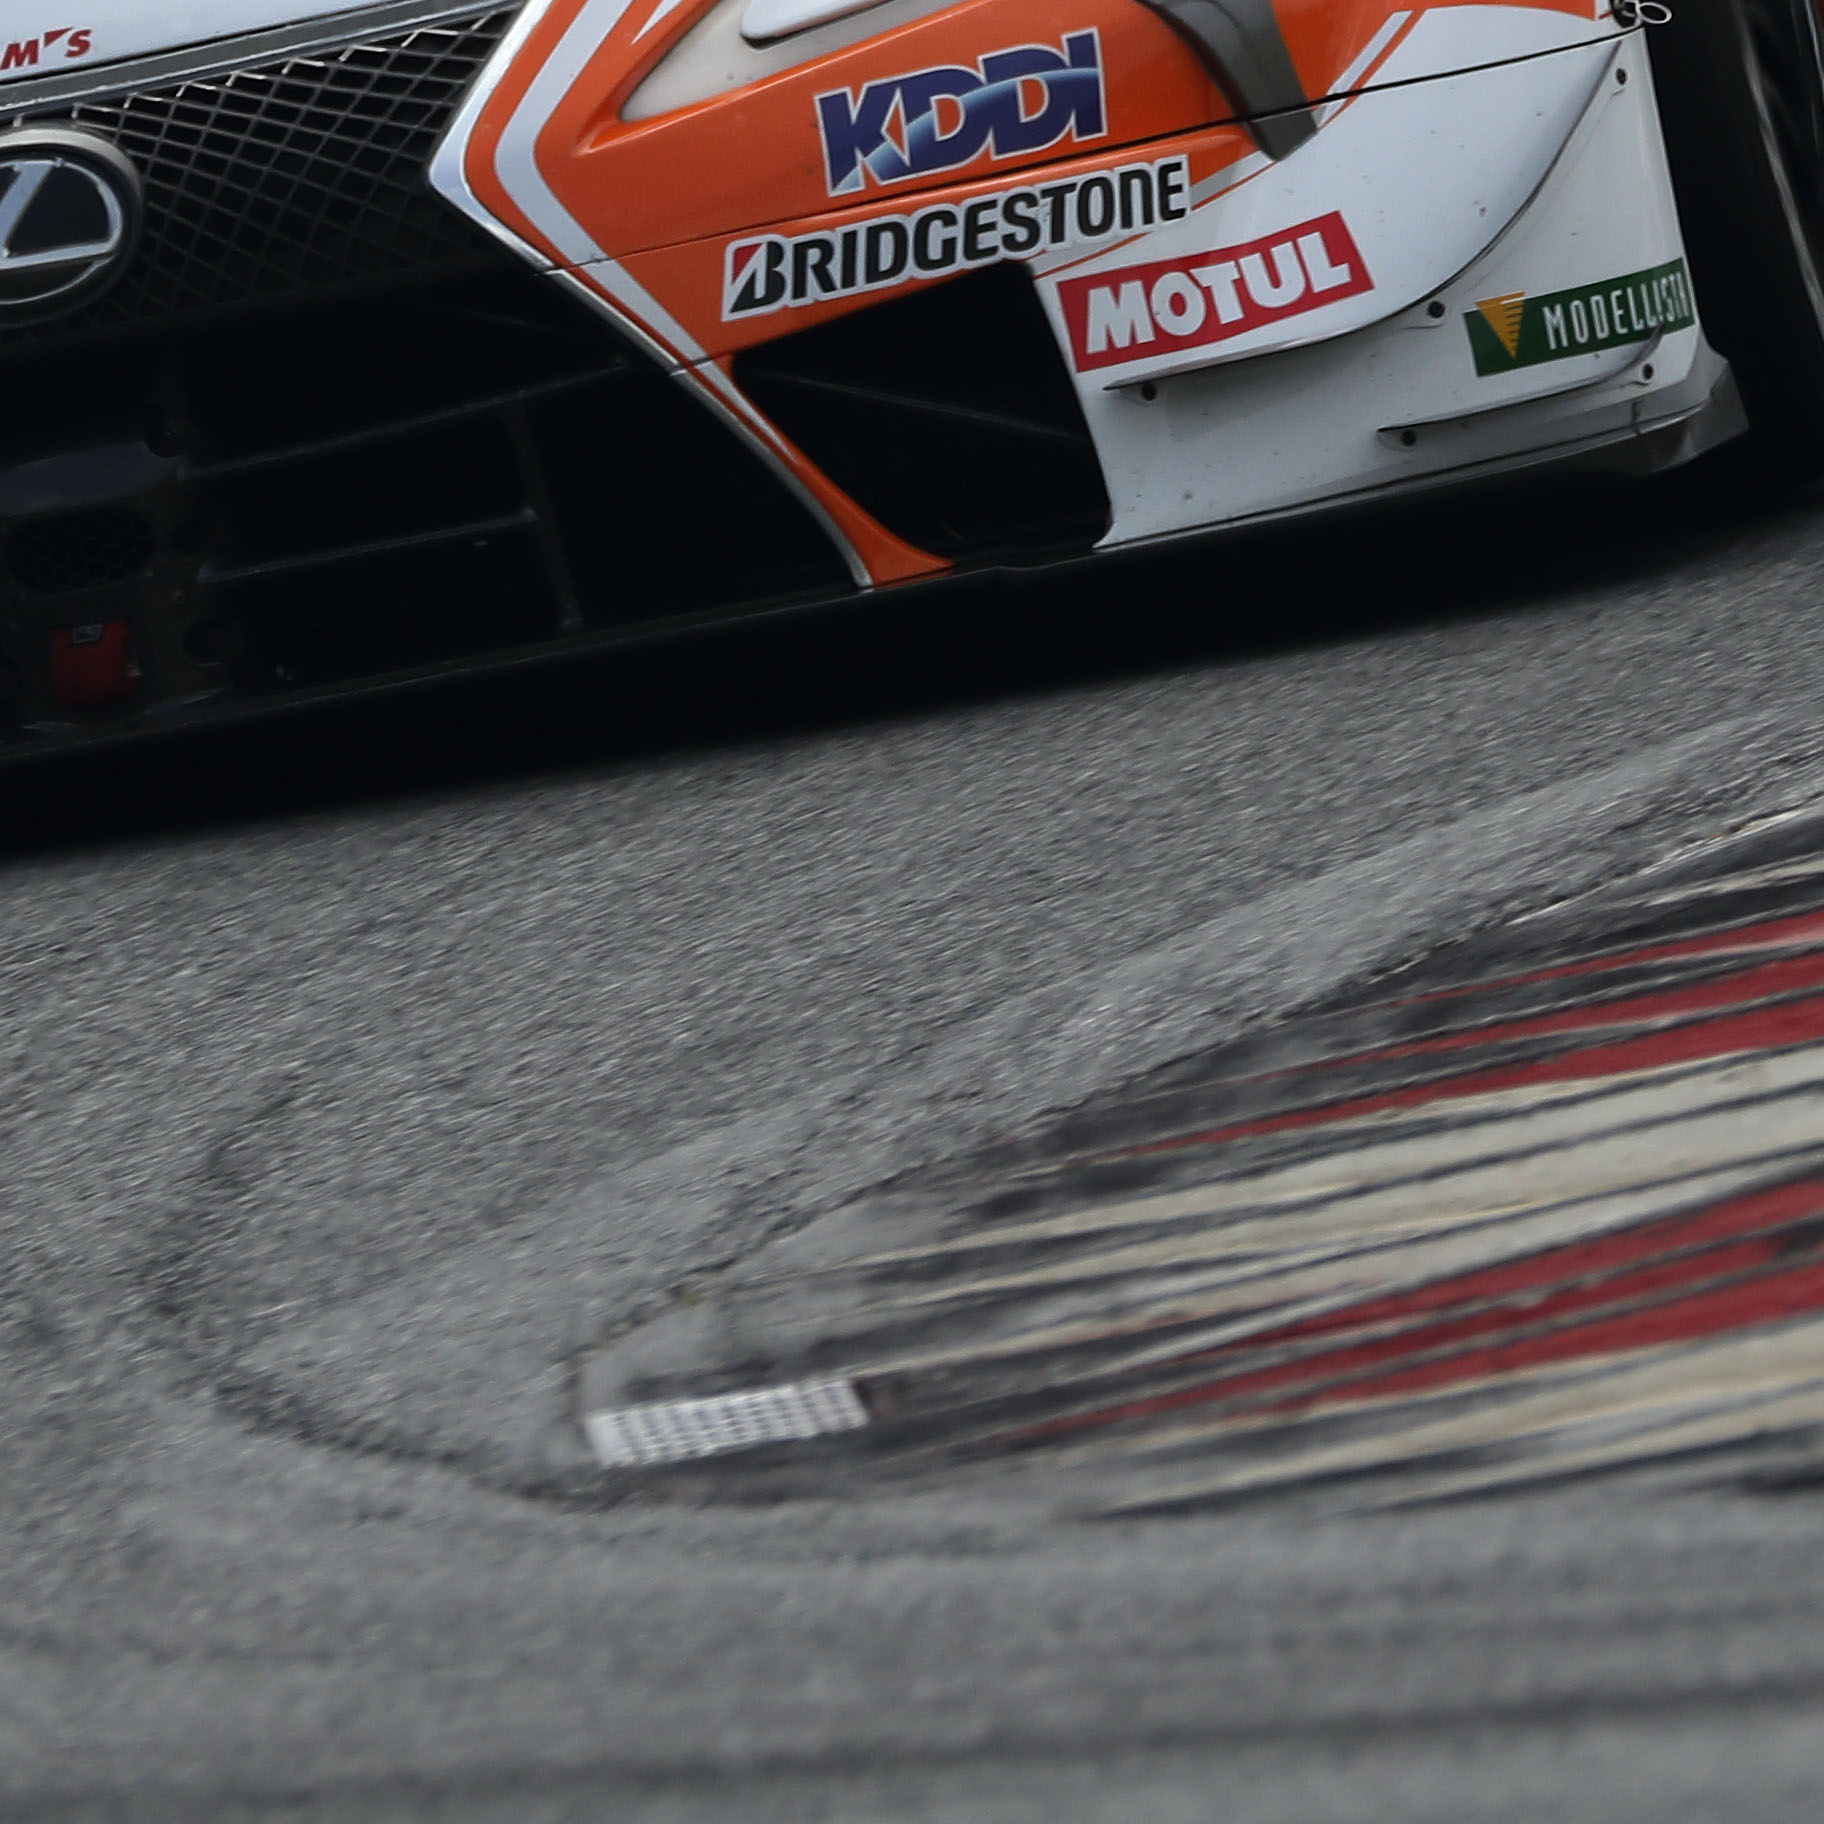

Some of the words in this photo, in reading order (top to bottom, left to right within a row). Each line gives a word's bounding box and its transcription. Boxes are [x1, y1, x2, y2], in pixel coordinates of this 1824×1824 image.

[813, 27, 1109, 198] KDDI
[729, 159, 1188, 316] BRIDGESTONE
[1084, 229, 1352, 355] MOTUL
